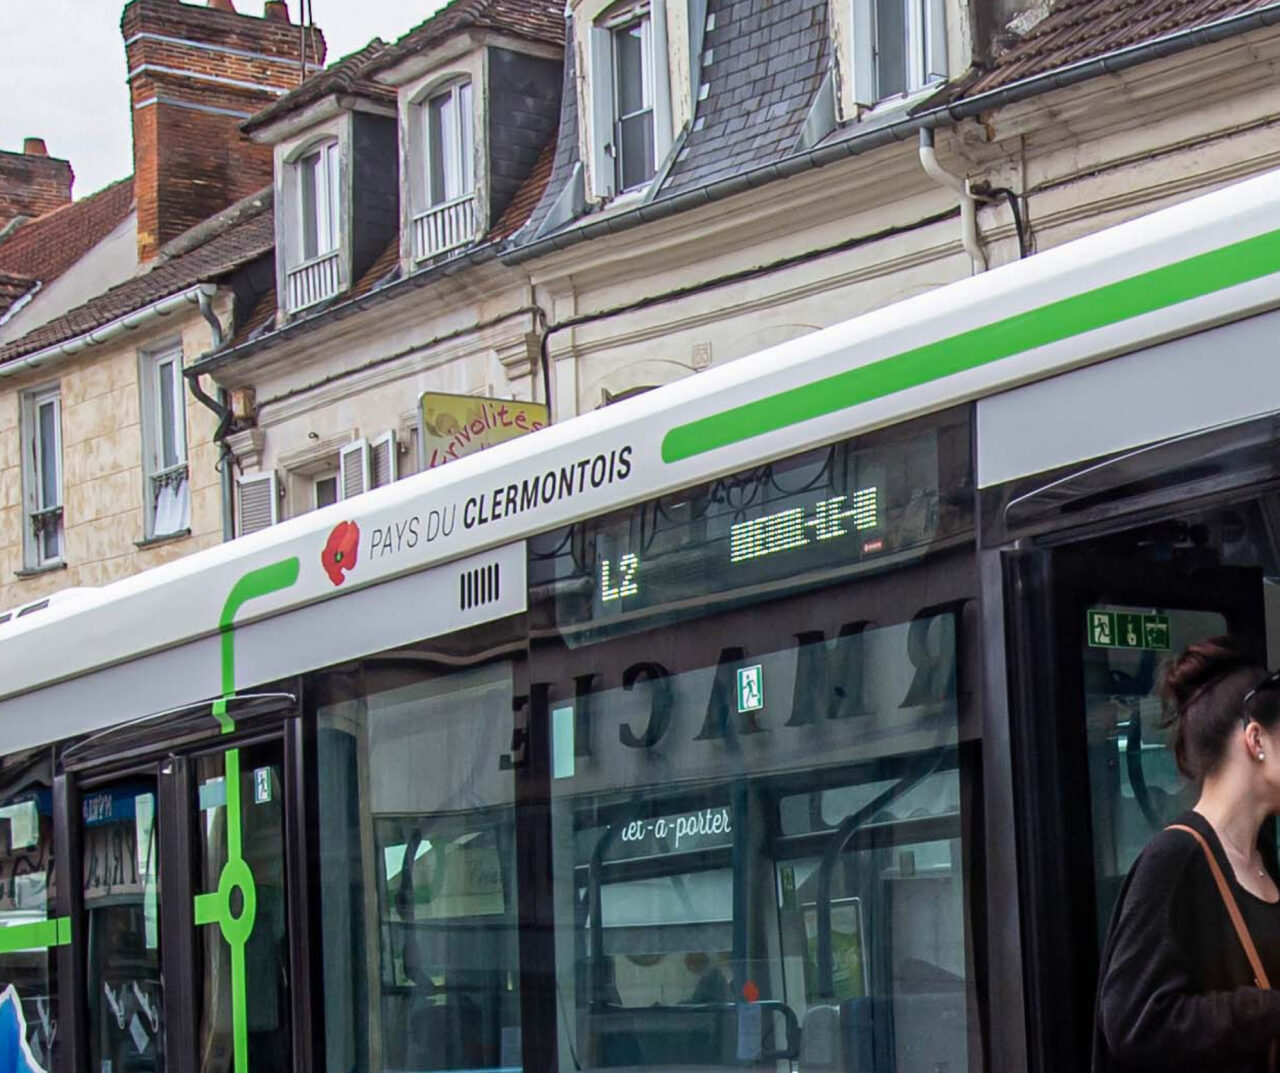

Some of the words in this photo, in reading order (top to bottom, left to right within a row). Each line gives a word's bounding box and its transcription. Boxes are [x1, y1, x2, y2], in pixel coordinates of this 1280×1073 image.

[370, 516, 420, 560] PAYS
[426, 503, 457, 543] DU
[462, 445, 633, 530] CLERMONTOIS
[602, 553, 638, 601] L2
